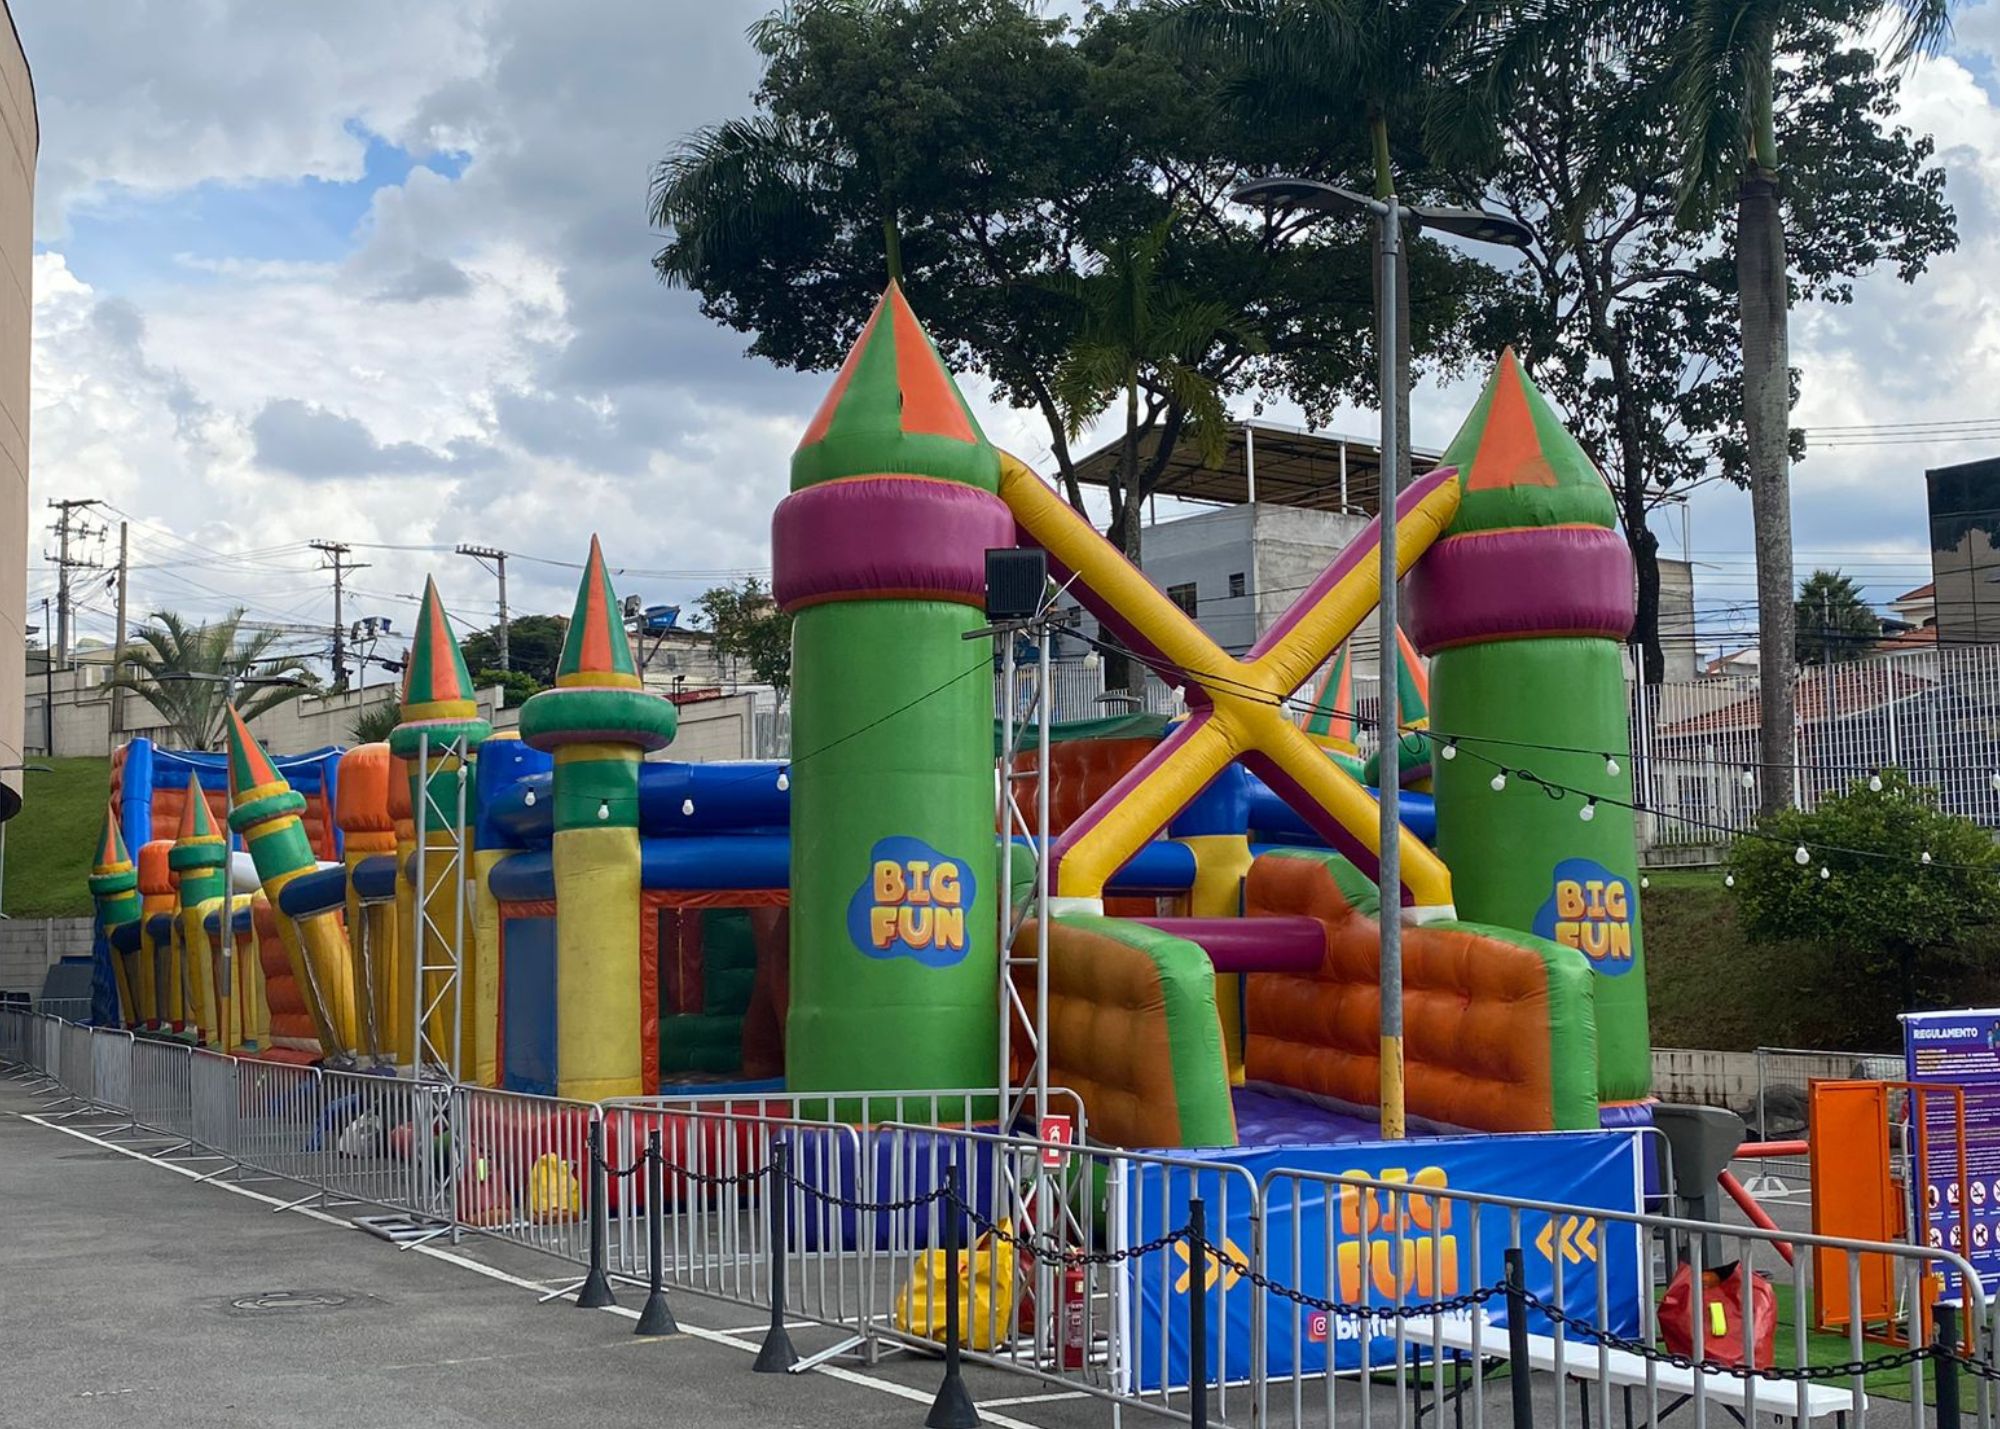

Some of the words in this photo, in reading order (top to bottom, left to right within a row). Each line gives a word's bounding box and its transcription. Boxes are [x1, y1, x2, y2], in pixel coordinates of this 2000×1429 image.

[873, 860, 961, 905] BIG
[1556, 880, 1627, 921] BIG
[870, 906, 964, 949] FUN
[1555, 921, 1632, 960] FUN
[1913, 1027, 1978, 1039] REGULAMENTO
[1339, 1166, 1453, 1236] BIG
